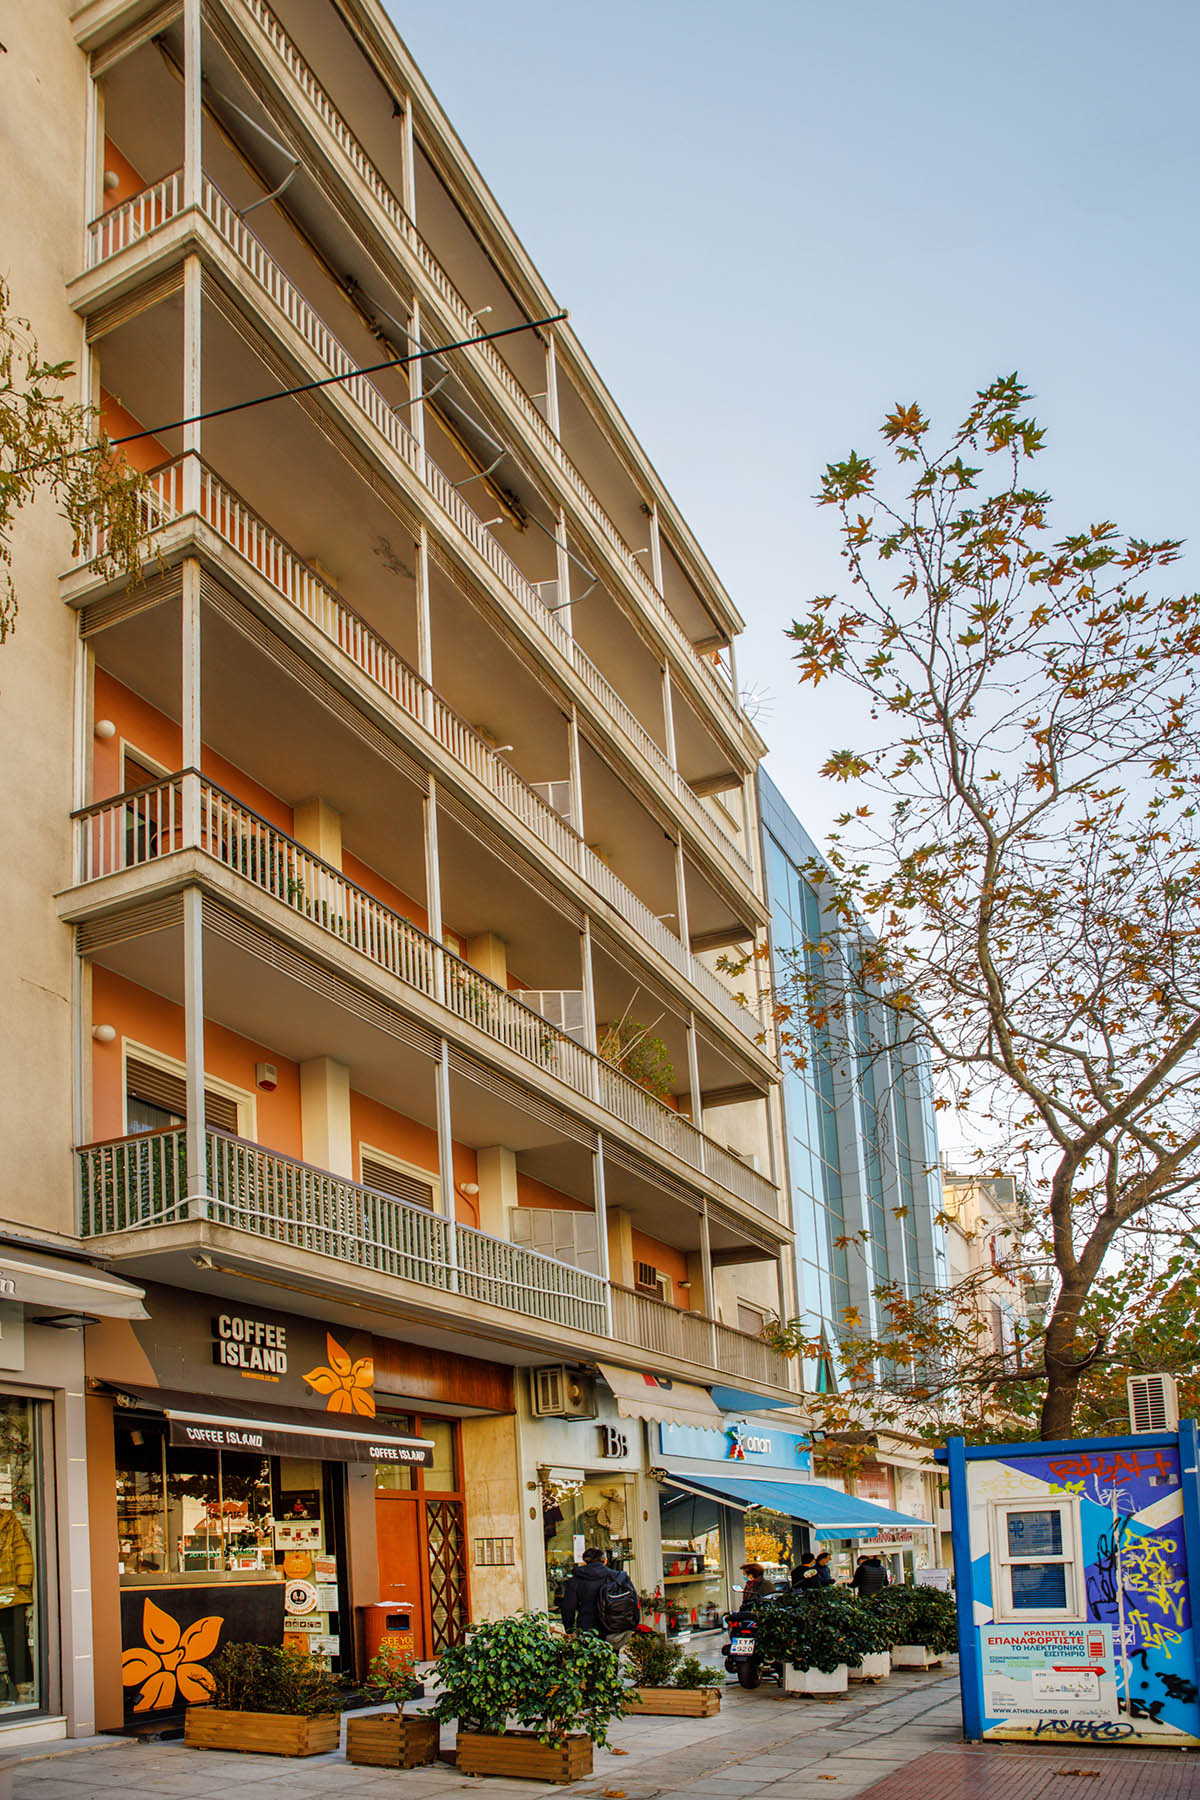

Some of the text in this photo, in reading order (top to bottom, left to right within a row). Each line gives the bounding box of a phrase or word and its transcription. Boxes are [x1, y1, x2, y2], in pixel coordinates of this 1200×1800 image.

[218, 1314, 287, 1349] COFFEE
[220, 1340, 288, 1374] ISLAND
[185, 1426, 263, 1448] COFFEE ISLAND
[369, 1446, 426, 1461] COFFEE ISLAND
[987, 1636, 1085, 1645] ΕΠΑΝΑΦΟΡΤΙΣΤΕ
[992, 1707, 1069, 1715] WWW.ATHENACARD.GR
